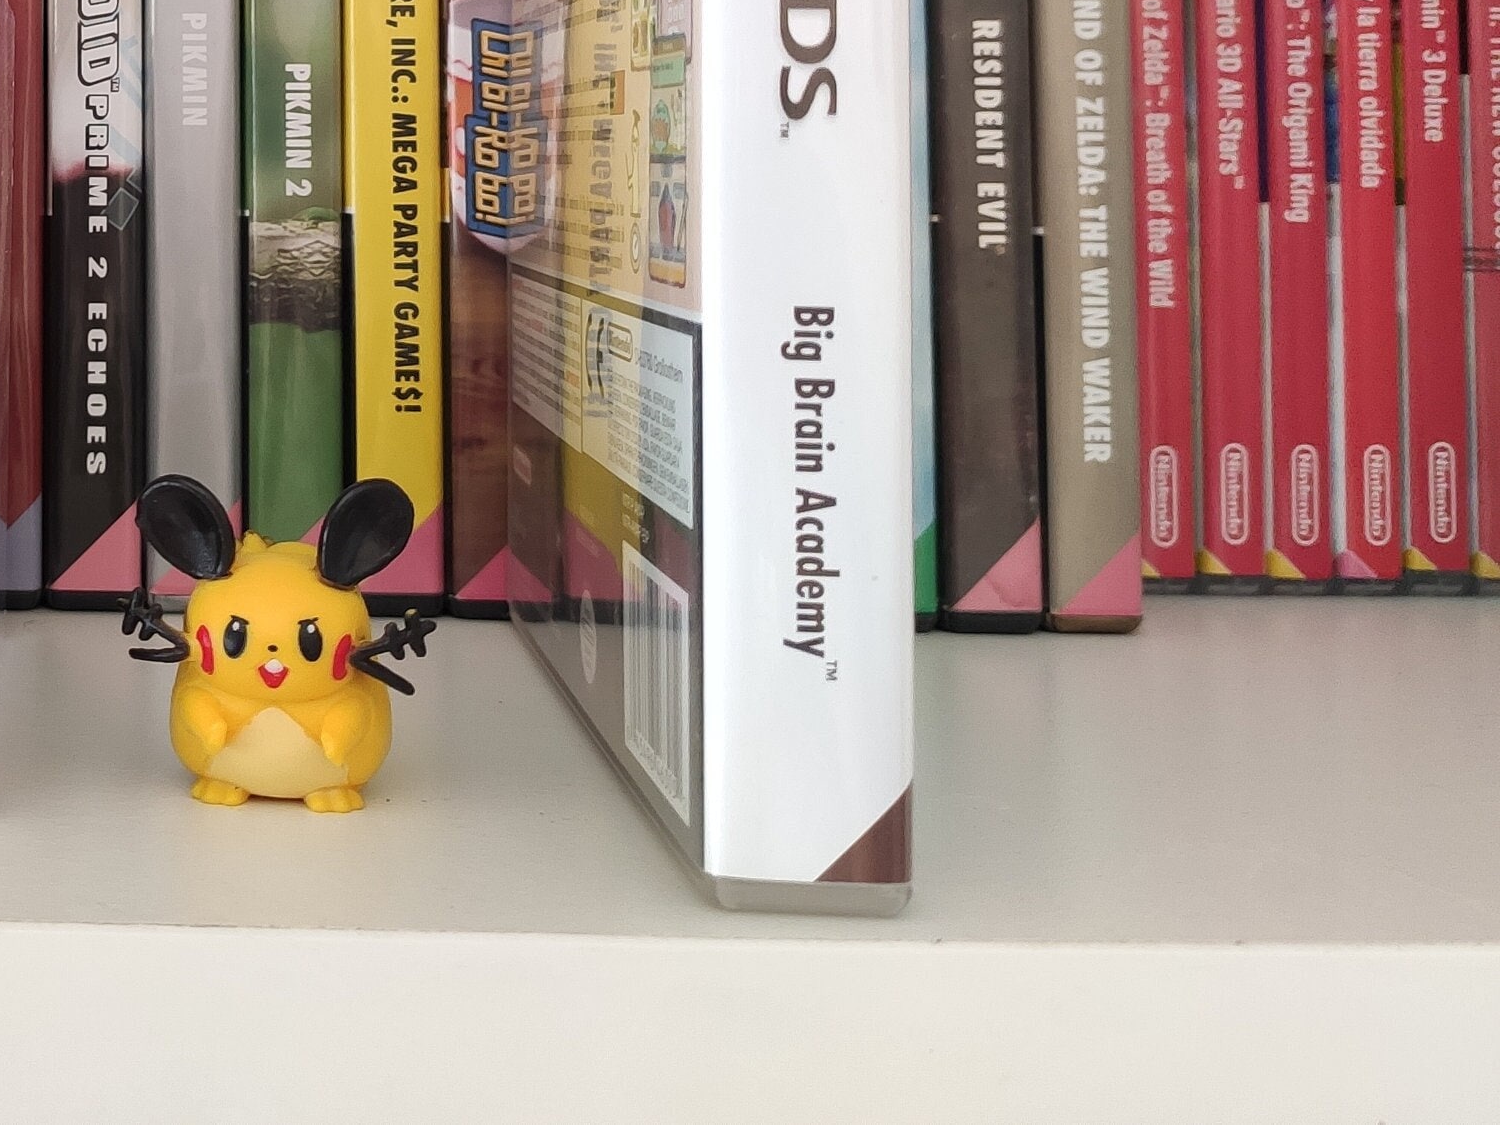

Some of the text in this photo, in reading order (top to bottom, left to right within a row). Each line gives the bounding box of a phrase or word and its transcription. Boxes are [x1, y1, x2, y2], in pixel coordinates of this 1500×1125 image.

[182, 13, 207, 126] PIKMIN
[391, 38, 416, 104] INC.:
[1074, 50, 1102, 87] OF
[86, 94, 109, 233] PRIME
[285, 63, 312, 197] PIKMIN 2
[392, 113, 417, 194] MEGA
[972, 19, 1008, 249] RESIDENT EVIL
[1075, 95, 1106, 195] ZELDA:
[1146, 114, 1172, 185] Breath
[1282, 82, 1314, 168] Origami
[1079, 205, 1107, 257] THE
[1285, 174, 1315, 223] King
[87, 257, 107, 278] 2
[393, 205, 418, 292] PARTY
[1148, 259, 1175, 307] Wild
[781, 305, 834, 361] Big
[1080, 268, 1110, 349] WIND
[86, 302, 107, 475] ECHOES
[794, 378, 835, 473] Brain
[1083, 358, 1112, 463] WAKER
